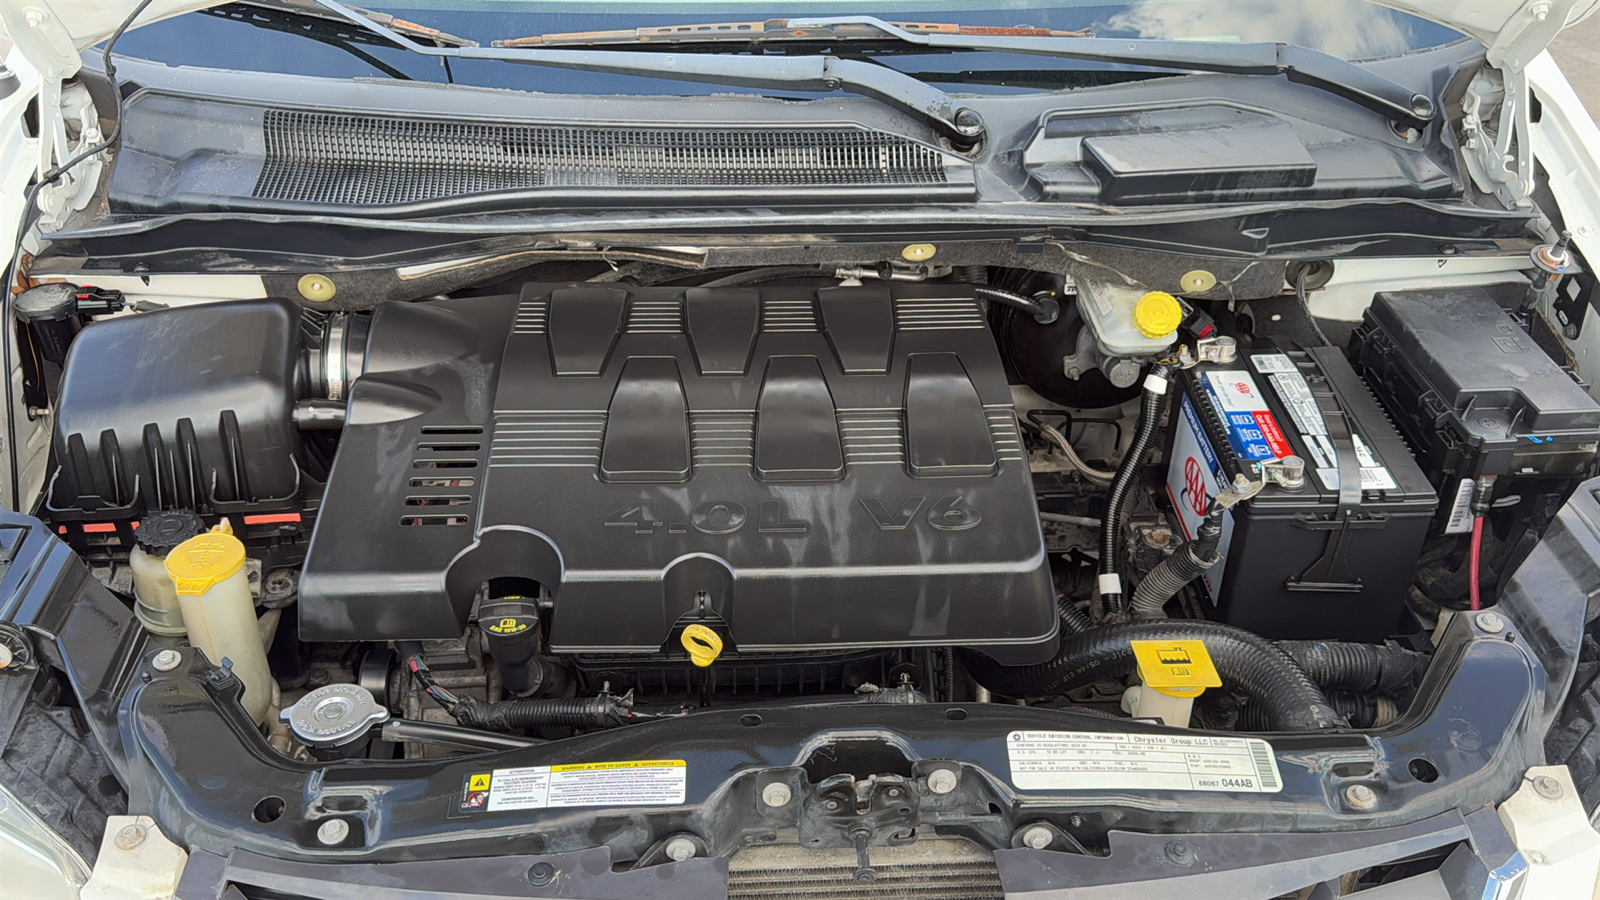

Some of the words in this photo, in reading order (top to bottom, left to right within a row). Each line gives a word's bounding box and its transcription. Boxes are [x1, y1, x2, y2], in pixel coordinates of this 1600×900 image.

[1184, 400, 1199, 434] PREMIUM
[1197, 432, 1214, 463] BATTERY
[605, 501, 807, 534] 4.0L
[859, 496, 982, 531] V6
[1133, 736, 1167, 745] Chrysler
[1170, 737, 1192, 747] Group
[1221, 778, 1253, 788] 044AB
